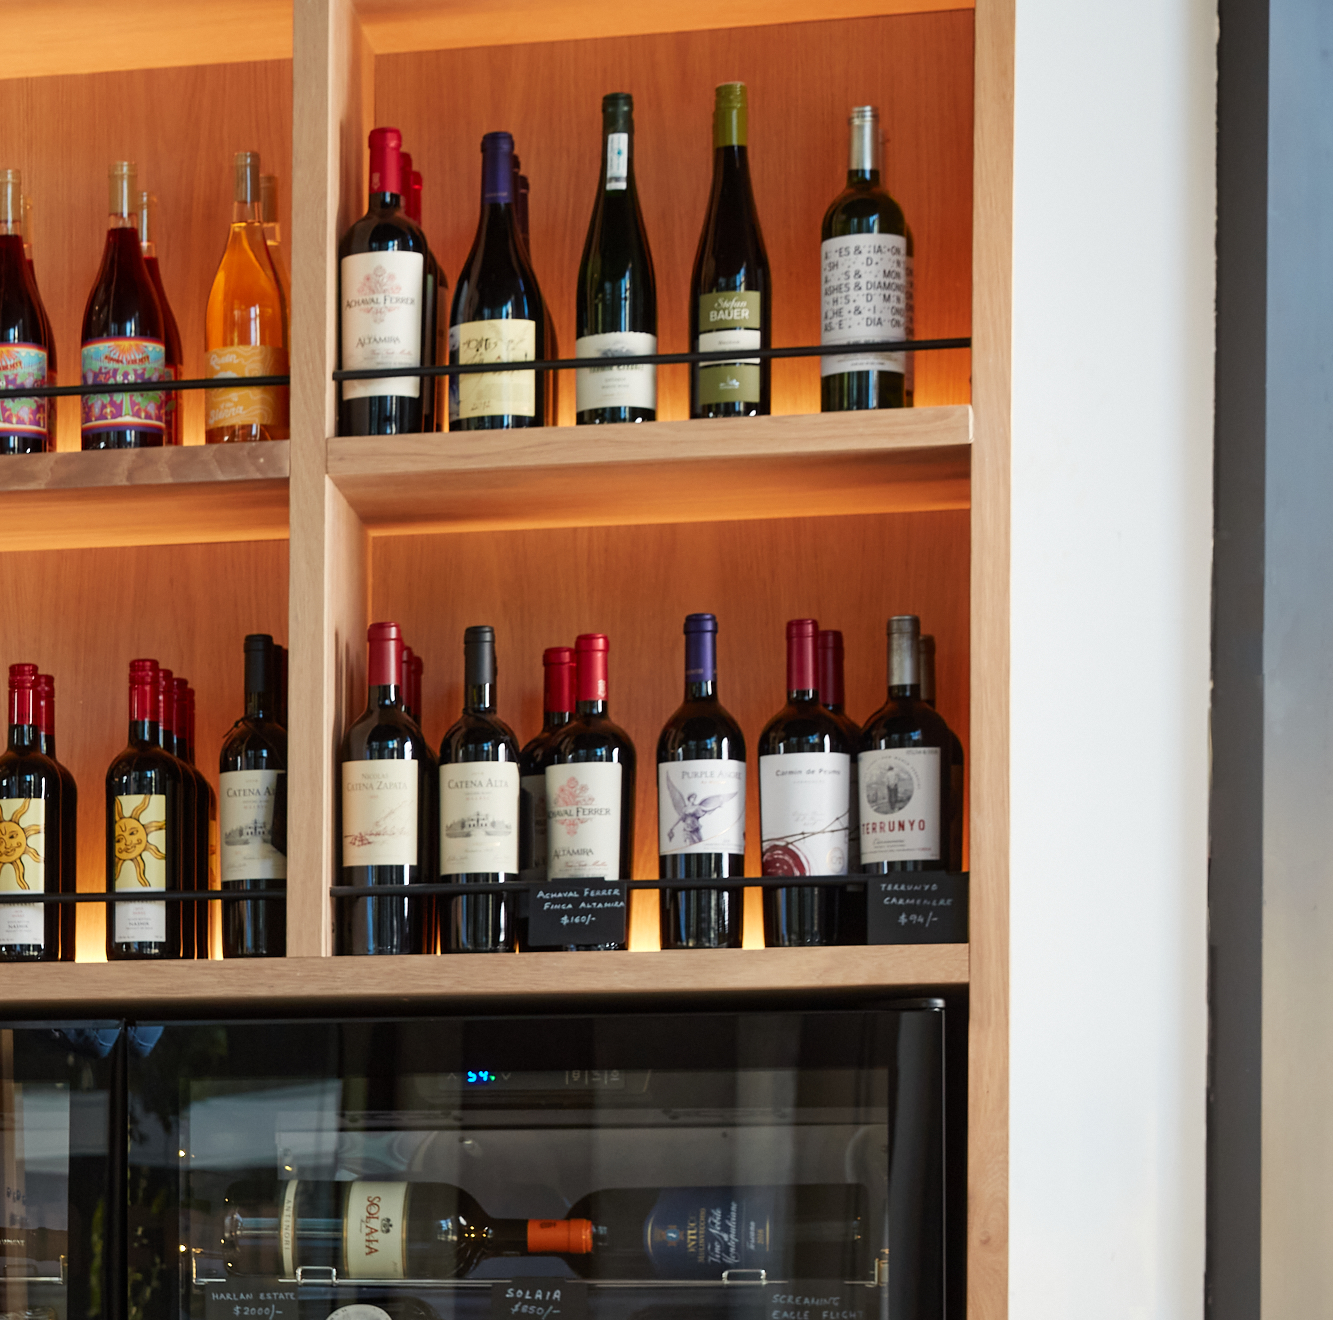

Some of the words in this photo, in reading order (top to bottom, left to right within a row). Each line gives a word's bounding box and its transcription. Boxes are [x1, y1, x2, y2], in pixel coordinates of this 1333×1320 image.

[714, 296, 747, 310] Stefan
[709, 308, 750, 322] BAUER
[681, 770, 714, 780] PURPLE
[376, 780, 408, 791] ZAPATA
[447, 778, 483, 790] CATENA
[485, 777, 509, 788] ALTA
[226, 787, 261, 798] CATENA
[575, 806, 611, 818] FERRER
[861, 818, 926, 836] TERRUNYO
[536, 889, 580, 899] ACHAVAL
[583, 887, 621, 898] FERRER
[880, 883, 938, 892] TERRUNYO
[365, 1195, 381, 1257] SOLAIA
[211, 1292, 254, 1301] HARLAN
[259, 1291, 296, 1301] ESTATE
[505, 1287, 562, 1301] SOLAIA
[771, 1310, 810, 1320] EAGLE
